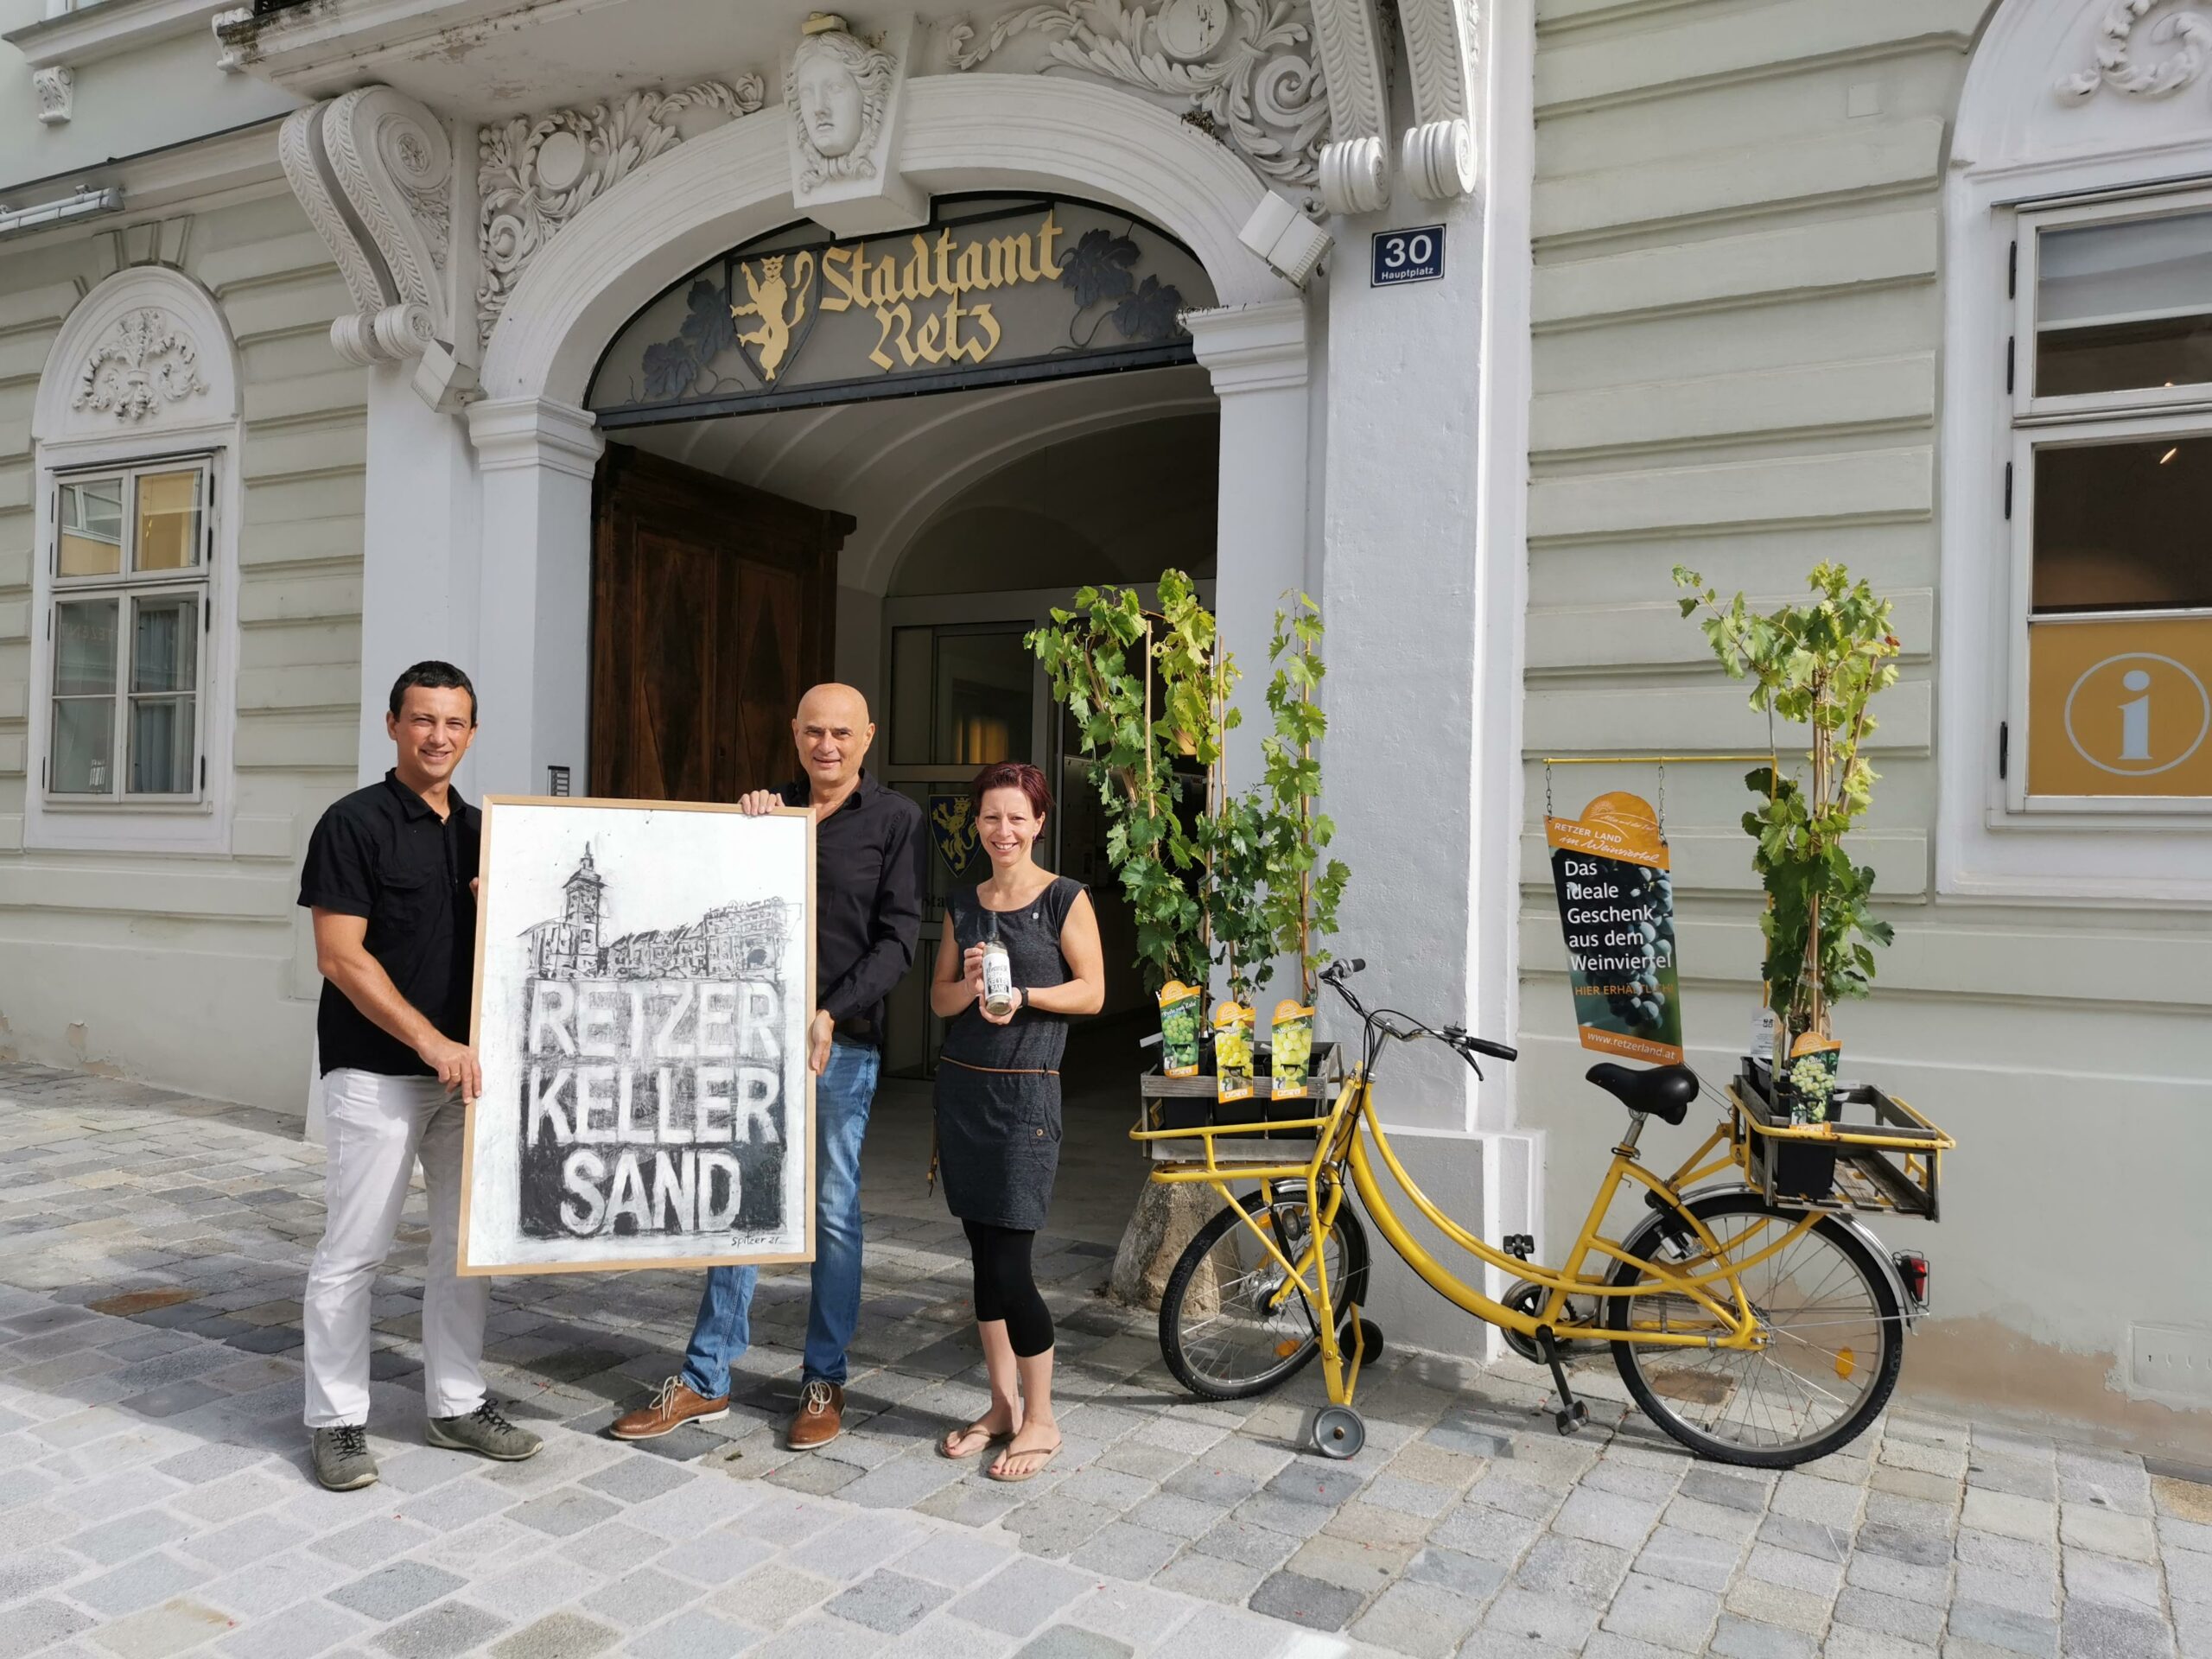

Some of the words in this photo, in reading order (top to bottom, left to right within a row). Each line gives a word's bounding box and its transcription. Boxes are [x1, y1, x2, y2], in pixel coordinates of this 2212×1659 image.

[820, 209, 1064, 312] Stadtamt
[1384, 234, 1433, 268] 30
[1381, 266, 1434, 281] Hauptplatz
[868, 289, 1001, 369] Retz
[1554, 822, 1592, 837] RETZER
[1594, 830, 1622, 843] LAND
[1559, 835, 1580, 847] im
[1565, 861, 1598, 876] Das
[1566, 881, 1619, 900] ideale
[1567, 904, 1654, 924] Geschenk
[1568, 933, 1599, 948] aus
[1604, 929, 1644, 946] dem
[1570, 950, 1671, 971] Weinviertel
[1574, 985, 1601, 995] HIER
[529, 980, 780, 1058] RETZER
[1587, 1032, 1675, 1059] www.retzerland.at
[529, 1066, 780, 1144] KELLER
[560, 1148, 742, 1236] SAND
